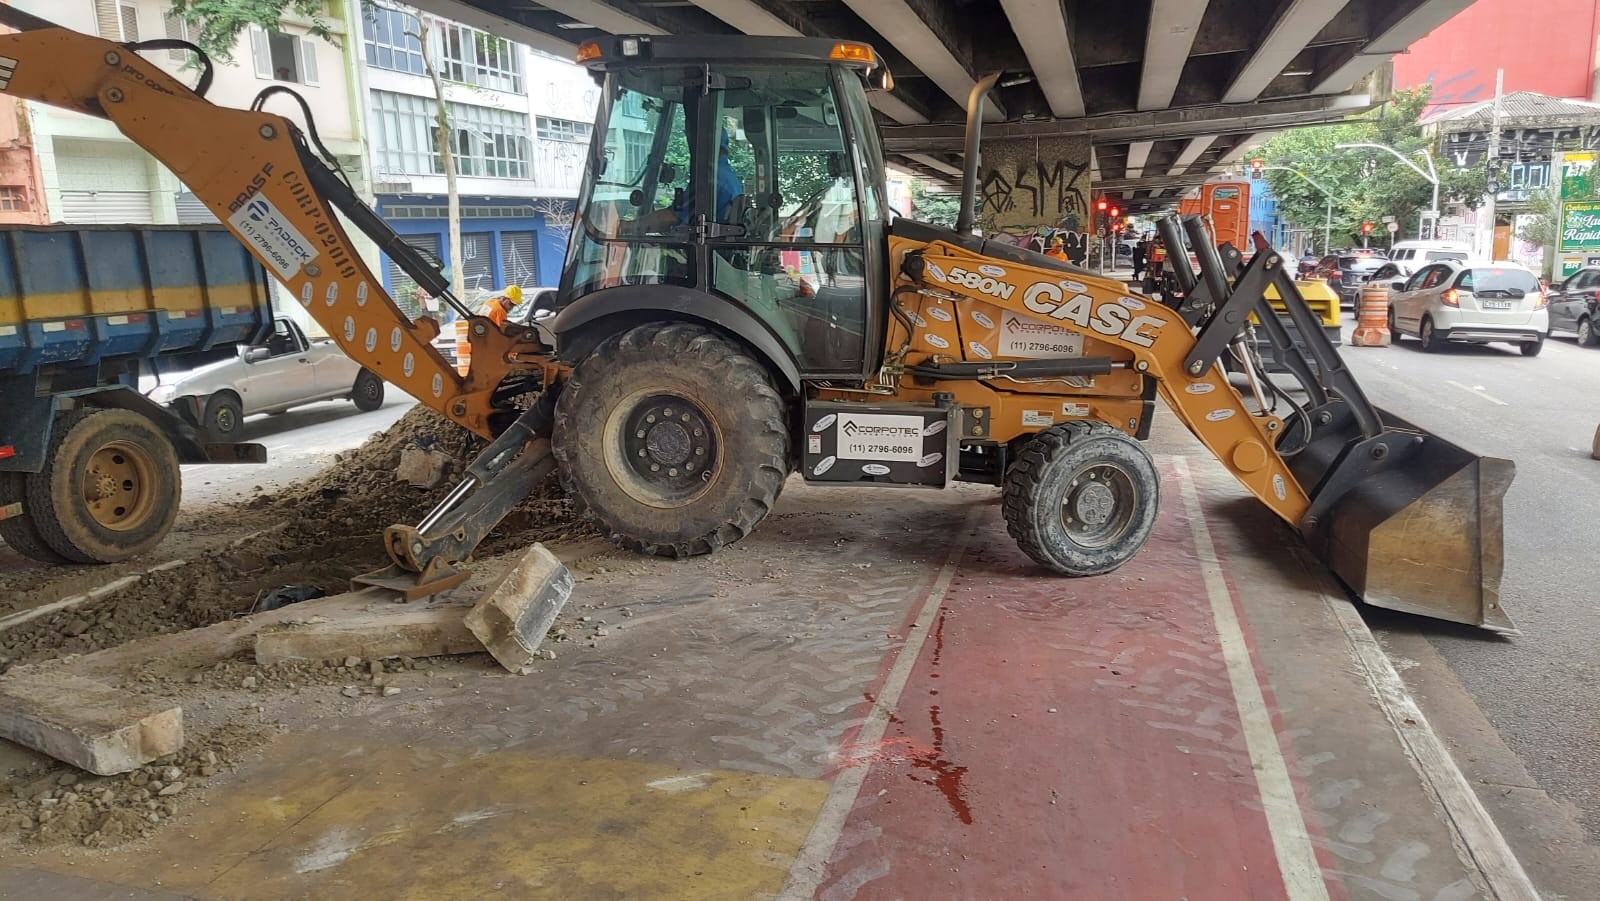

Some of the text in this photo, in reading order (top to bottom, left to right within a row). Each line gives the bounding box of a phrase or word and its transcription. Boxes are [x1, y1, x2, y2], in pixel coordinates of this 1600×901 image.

[240, 220, 256, 236] (11)
[254, 233, 290, 269] 2796-6096
[268, 217, 311, 260] PADOCK
[946, 267, 1016, 300] 580N
[1023, 281, 1168, 348] CASE
[1021, 323, 1080, 334] CORPOT
[1010, 341, 1074, 353] (11) 2796-6096
[858, 425, 919, 435] CORPOTEC
[849, 443, 913, 454] (11) 2796-6096
